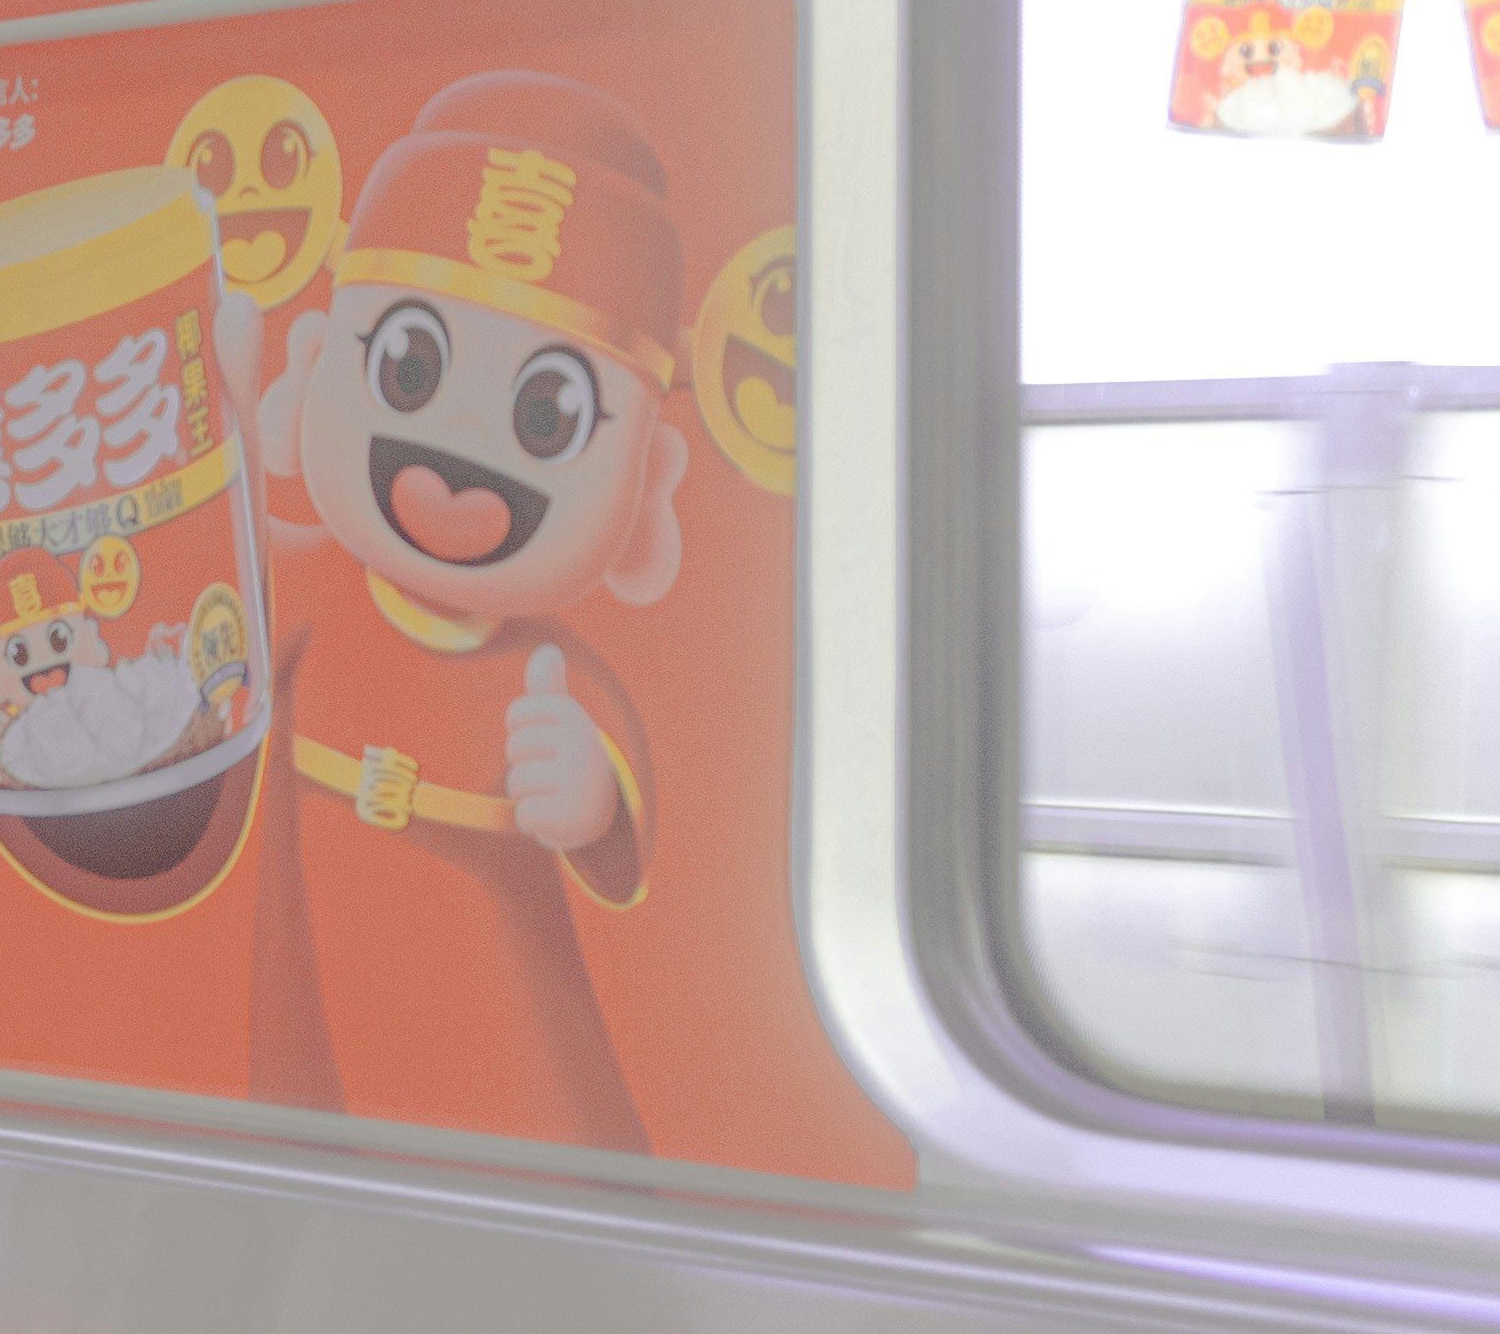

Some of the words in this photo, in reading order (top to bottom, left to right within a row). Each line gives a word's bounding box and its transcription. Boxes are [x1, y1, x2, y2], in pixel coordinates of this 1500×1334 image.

[467, 147, 576, 281] 喜
[175, 309, 215, 458] 椰果王
